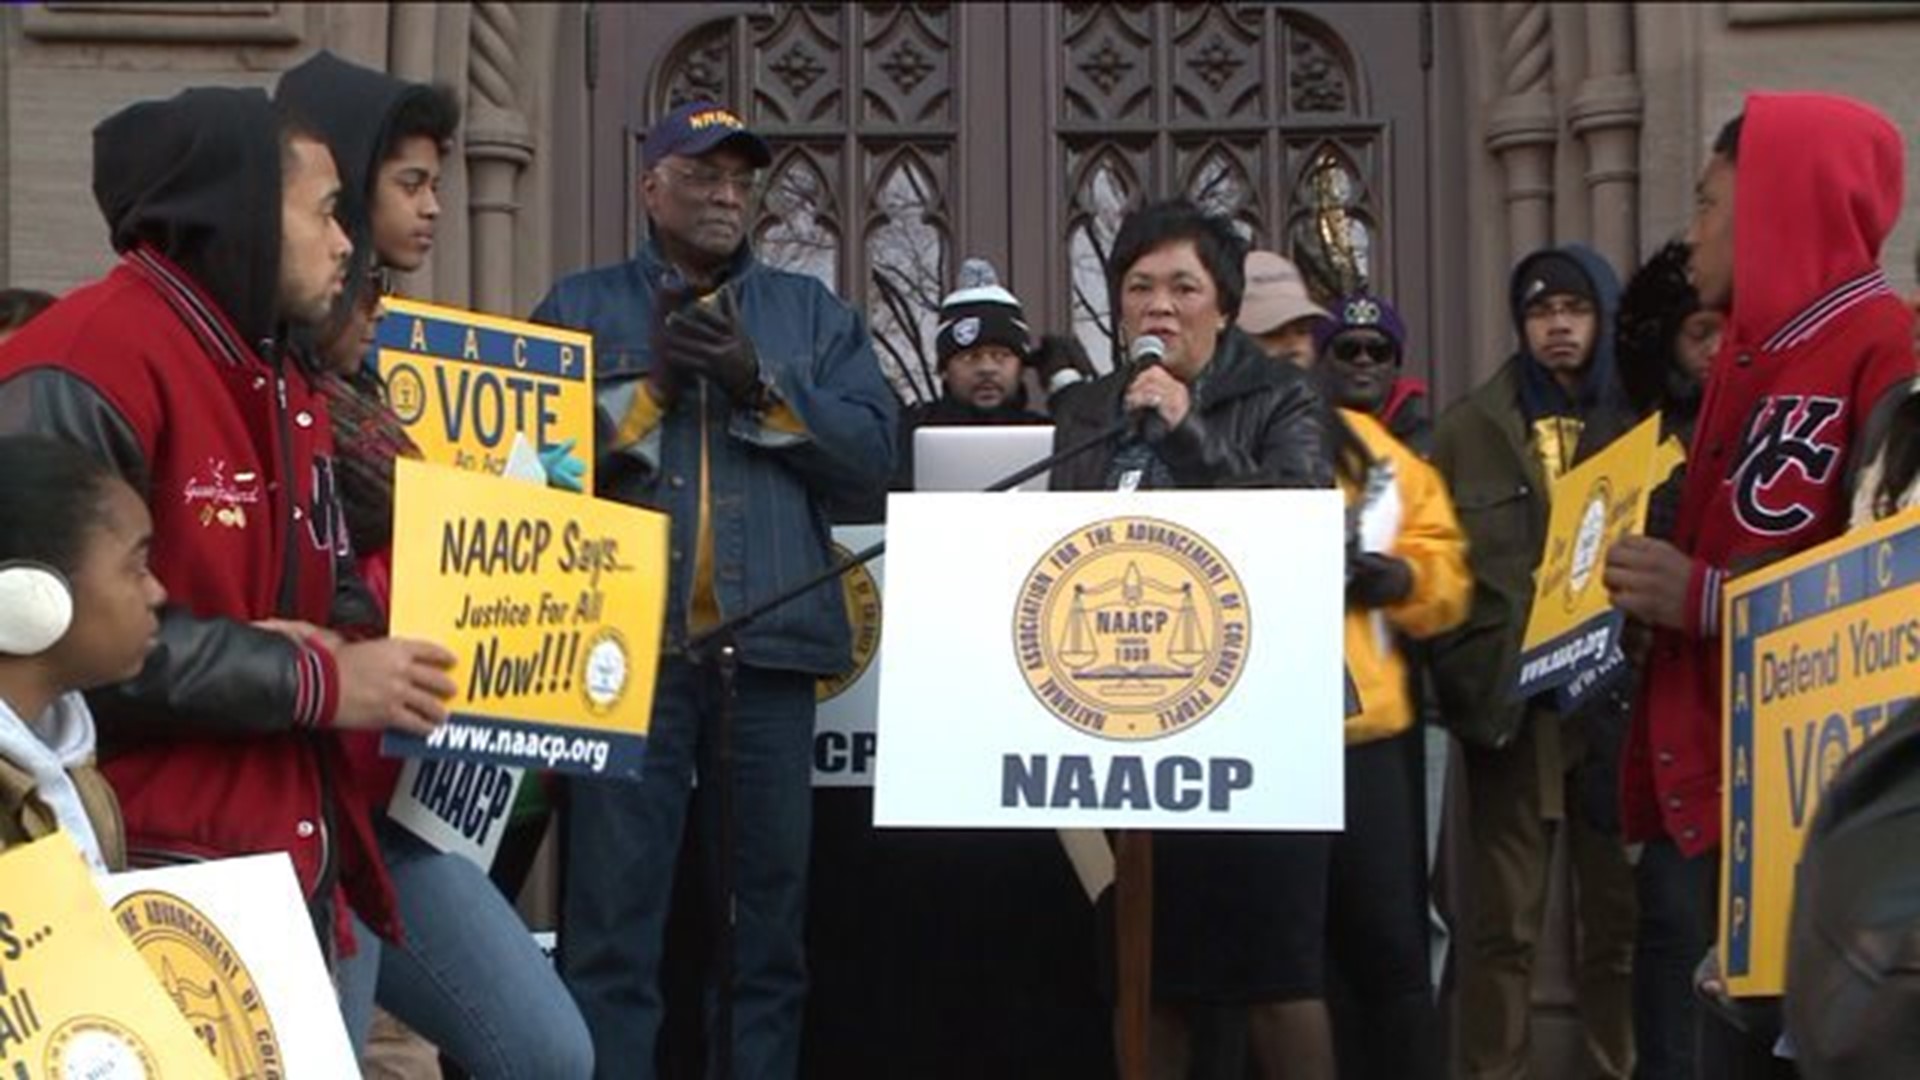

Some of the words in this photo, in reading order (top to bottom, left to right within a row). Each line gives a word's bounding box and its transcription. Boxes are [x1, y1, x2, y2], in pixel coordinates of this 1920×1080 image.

[434, 364, 561, 452] VOTE
[440, 517, 552, 576] NAACP
[1050, 542, 1081, 570] FOR
[1085, 525, 1115, 548] THE
[1126, 523, 1230, 585] ADVANCEMENT
[455, 594, 531, 629] Justice
[537, 592, 569, 626] For
[1019, 571, 1054, 671] ASSOCIATION
[1097, 611, 1168, 634] NAACP
[1220, 593, 1241, 610] OF
[467, 632, 581, 702] Now!!!
[1208, 622, 1244, 688] COLORED
[1761, 632, 1839, 704] Defend
[1037, 678, 1108, 731] NATIONAL
[1157, 689, 1213, 730] PEOPLE
[426, 722, 610, 772] www.naacp.org
[411, 757, 514, 847] NAACP
[1001, 754, 1254, 812] NAACP
